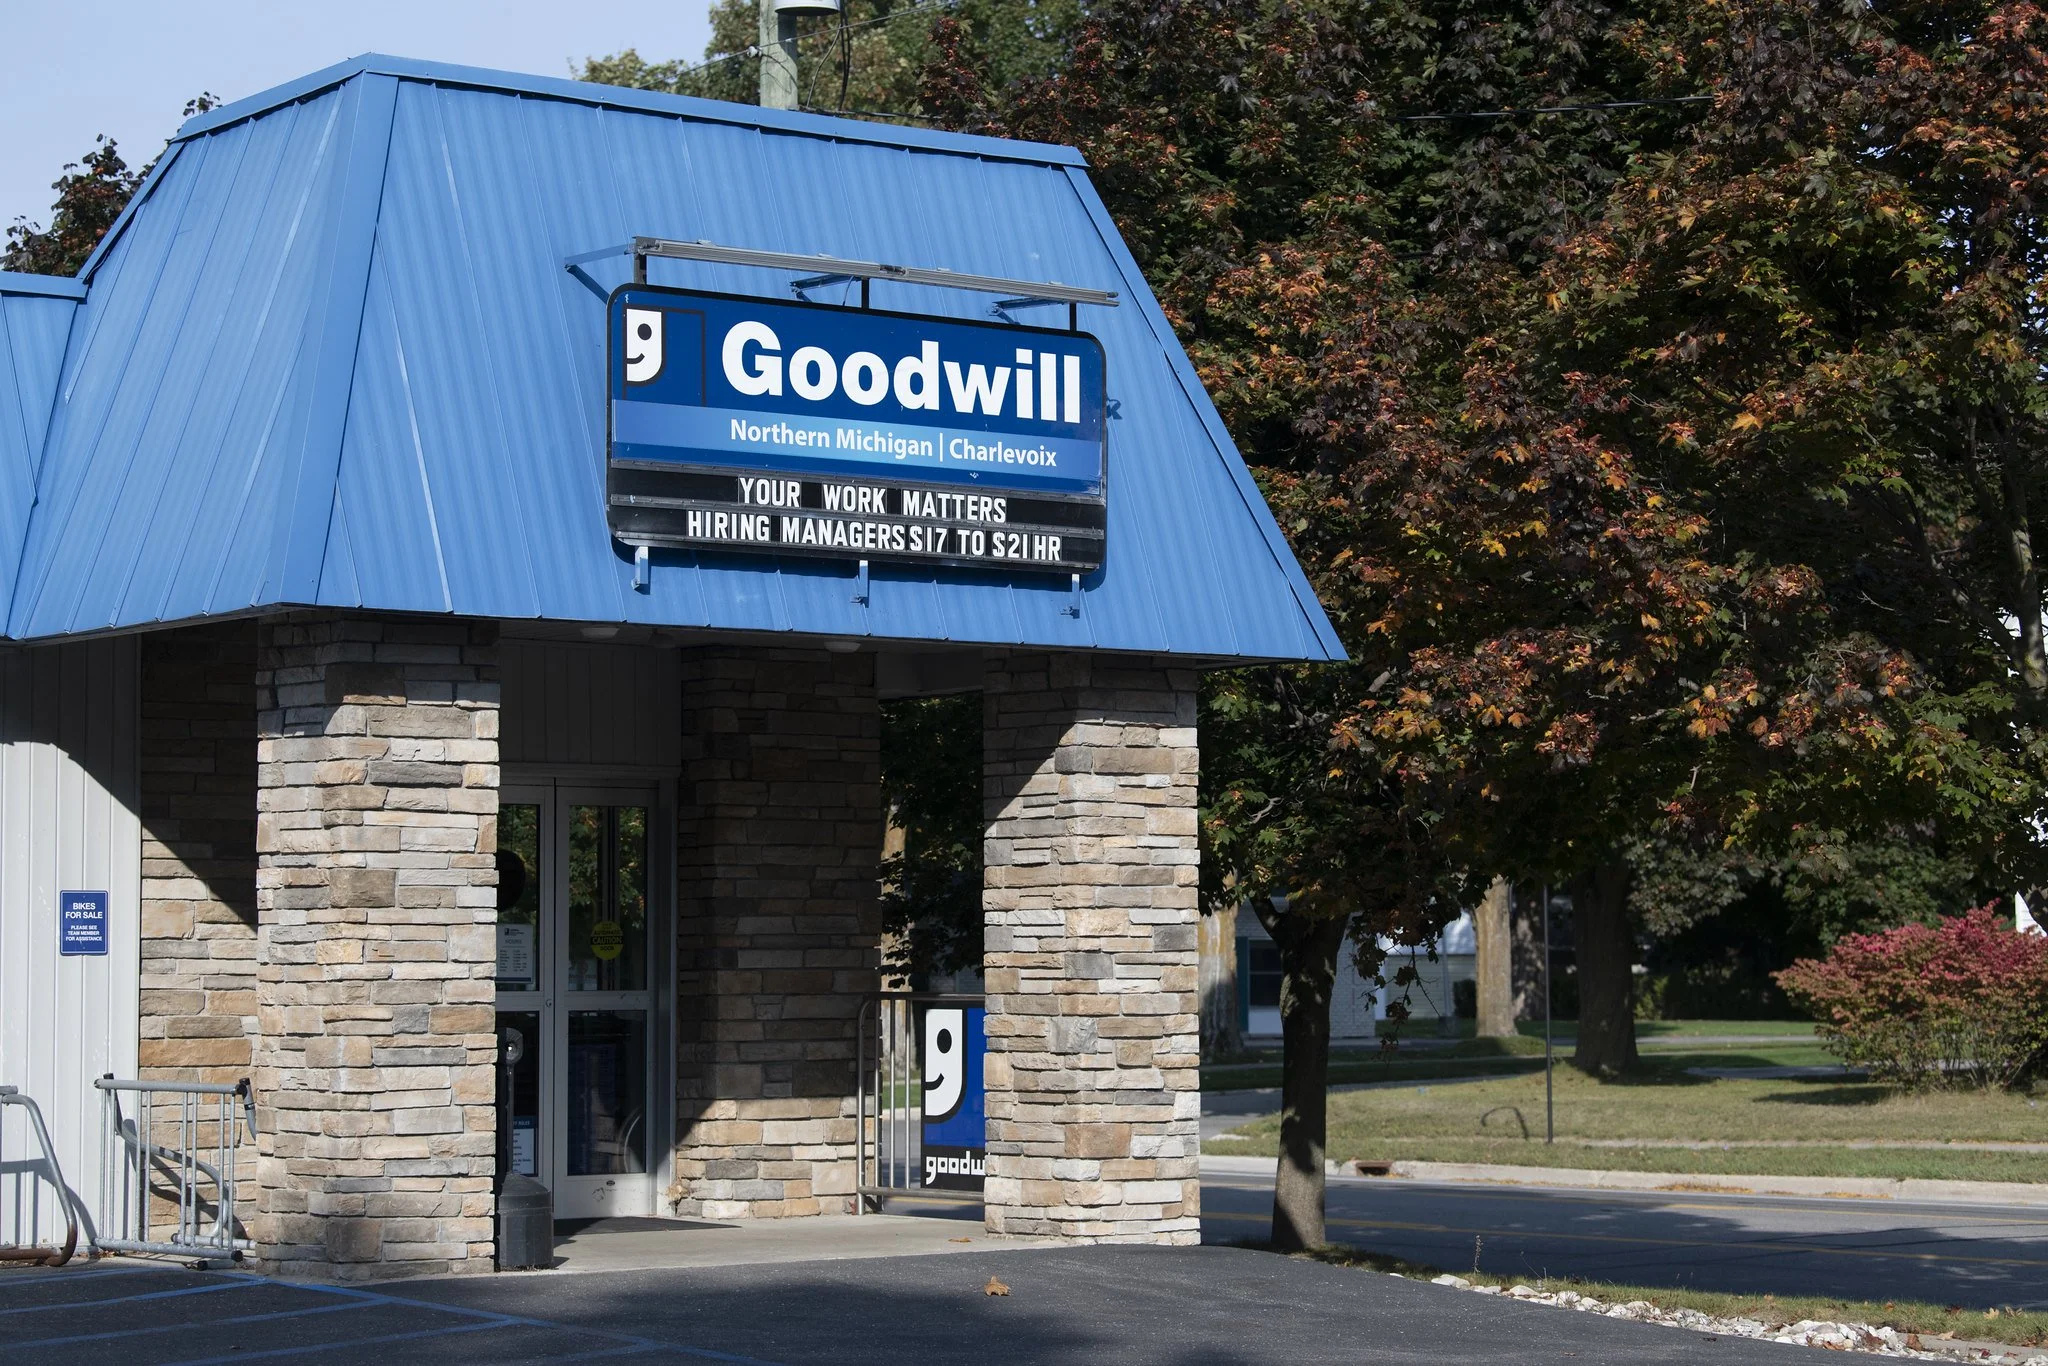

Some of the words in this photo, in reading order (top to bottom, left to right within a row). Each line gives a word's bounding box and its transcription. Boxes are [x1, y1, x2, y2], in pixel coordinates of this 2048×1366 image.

[722, 320, 1081, 424] Goodwill
[730, 418, 831, 449] Northern
[835, 427, 934, 461] Michigan
[949, 437, 1057, 468] Charlevoix
[739, 477, 800, 508] YOUR
[823, 484, 886, 514] WORK
[903, 490, 1007, 523] MATTERS
[688, 510, 770, 542] HIRING
[782, 516, 905, 551] MANAGERS
[957, 529, 985, 556] TO
[1034, 534, 1062, 561] HR
[65, 911, 82, 919] FOR
[82, 911, 103, 919] SALE
[72, 902, 96, 910] BIKES
[592, 936, 622, 945] CAUTION
